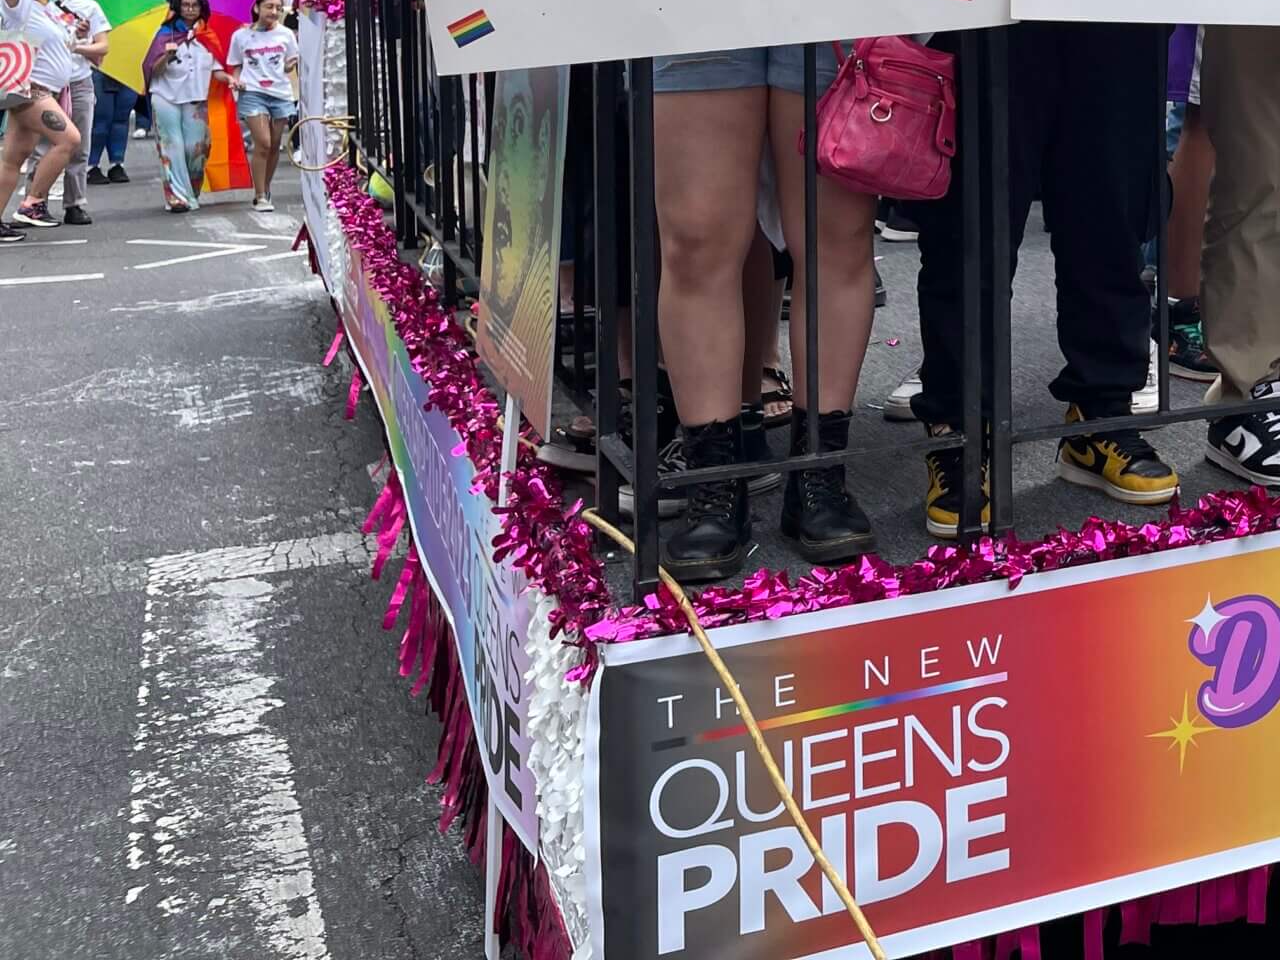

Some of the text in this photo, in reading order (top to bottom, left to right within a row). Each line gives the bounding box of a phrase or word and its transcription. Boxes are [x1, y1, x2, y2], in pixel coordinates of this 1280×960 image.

[656, 633, 1004, 729] THE NEW
[648, 696, 1011, 839] QUEENS
[656, 776, 1011, 956] PRIDE
